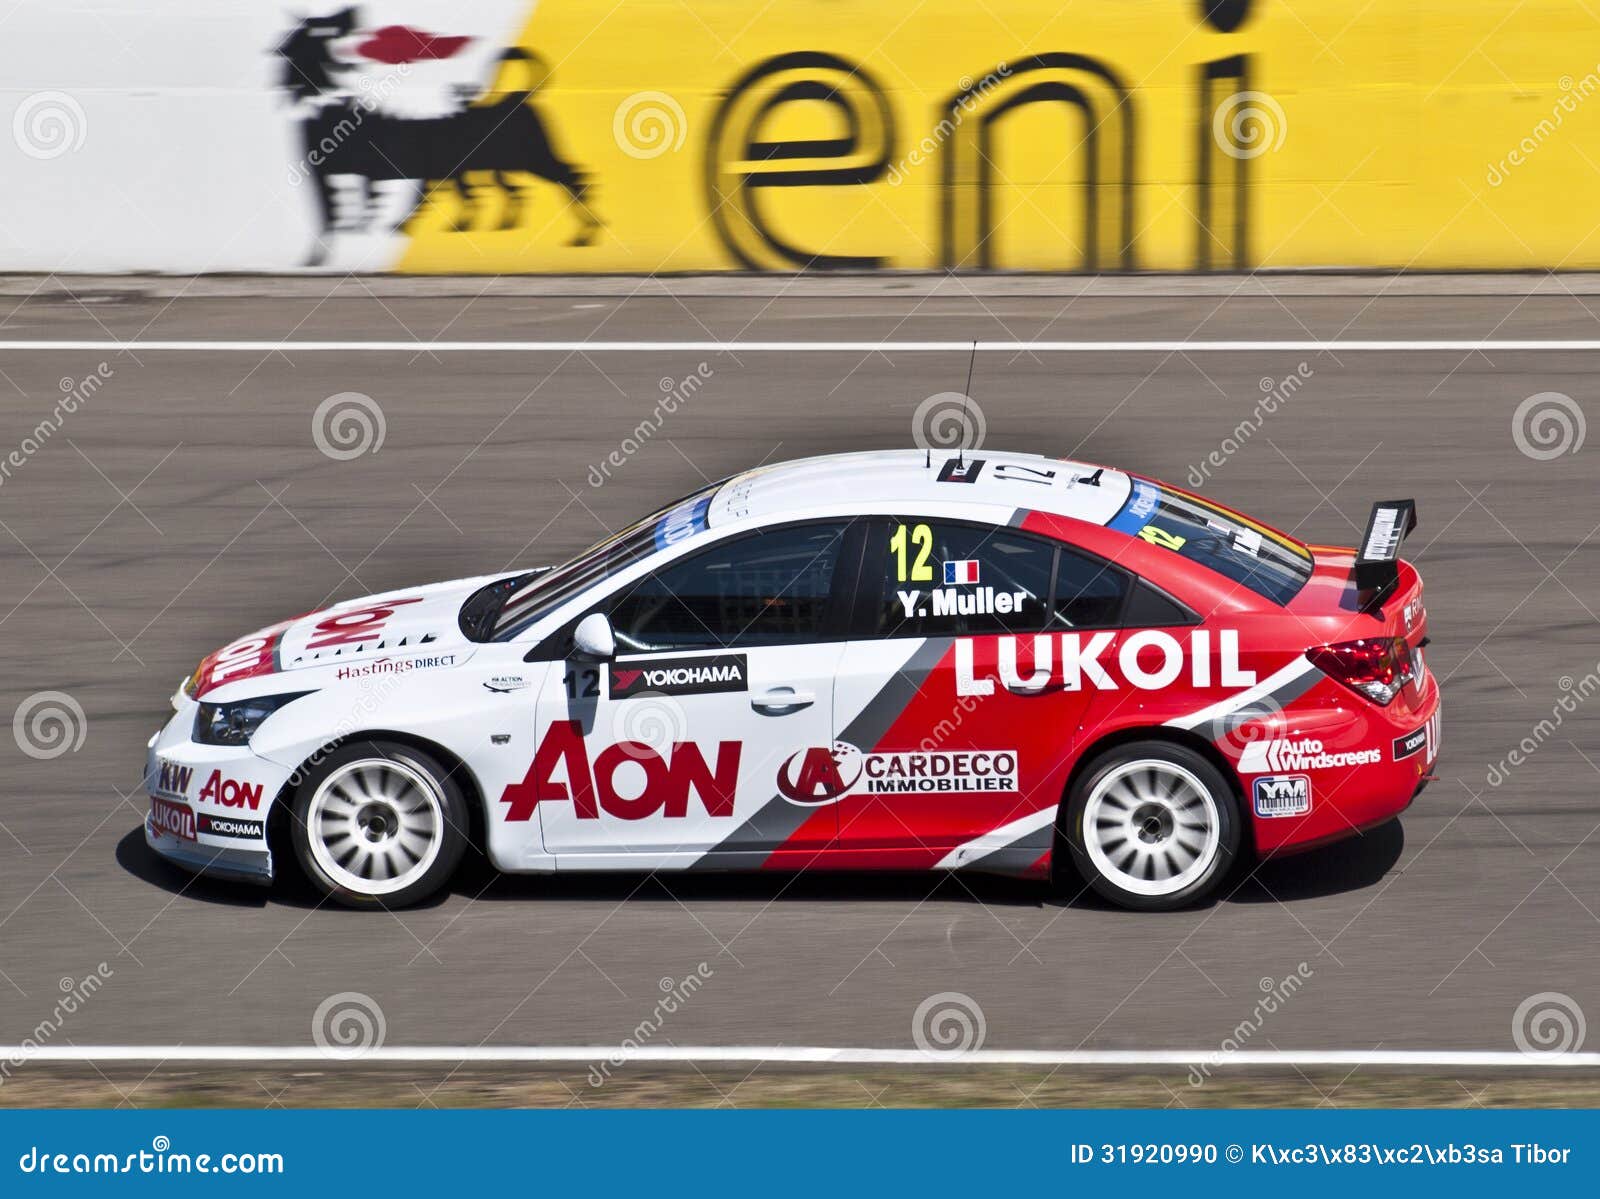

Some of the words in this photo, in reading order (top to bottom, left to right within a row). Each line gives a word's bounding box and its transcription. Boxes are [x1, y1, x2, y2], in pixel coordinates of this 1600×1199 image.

[706, 0, 1258, 271] eni
[889, 524, 933, 582] 12
[897, 590, 927, 618] Y.
[932, 586, 1028, 617] Muller
[642, 664, 743, 687] YOKOHAMA
[954, 629, 1256, 697] LUKOIL
[562, 668, 601, 699] 12
[1280, 748, 1381, 771] Windscreens
[1283, 738, 1323, 755] Auto
[499, 720, 743, 821] AON
[864, 753, 1015, 778] CARDECO
[199, 769, 264, 811] AON
[867, 777, 1014, 793] IMMOBILIER
[210, 820, 262, 836] YOKOHAMA
